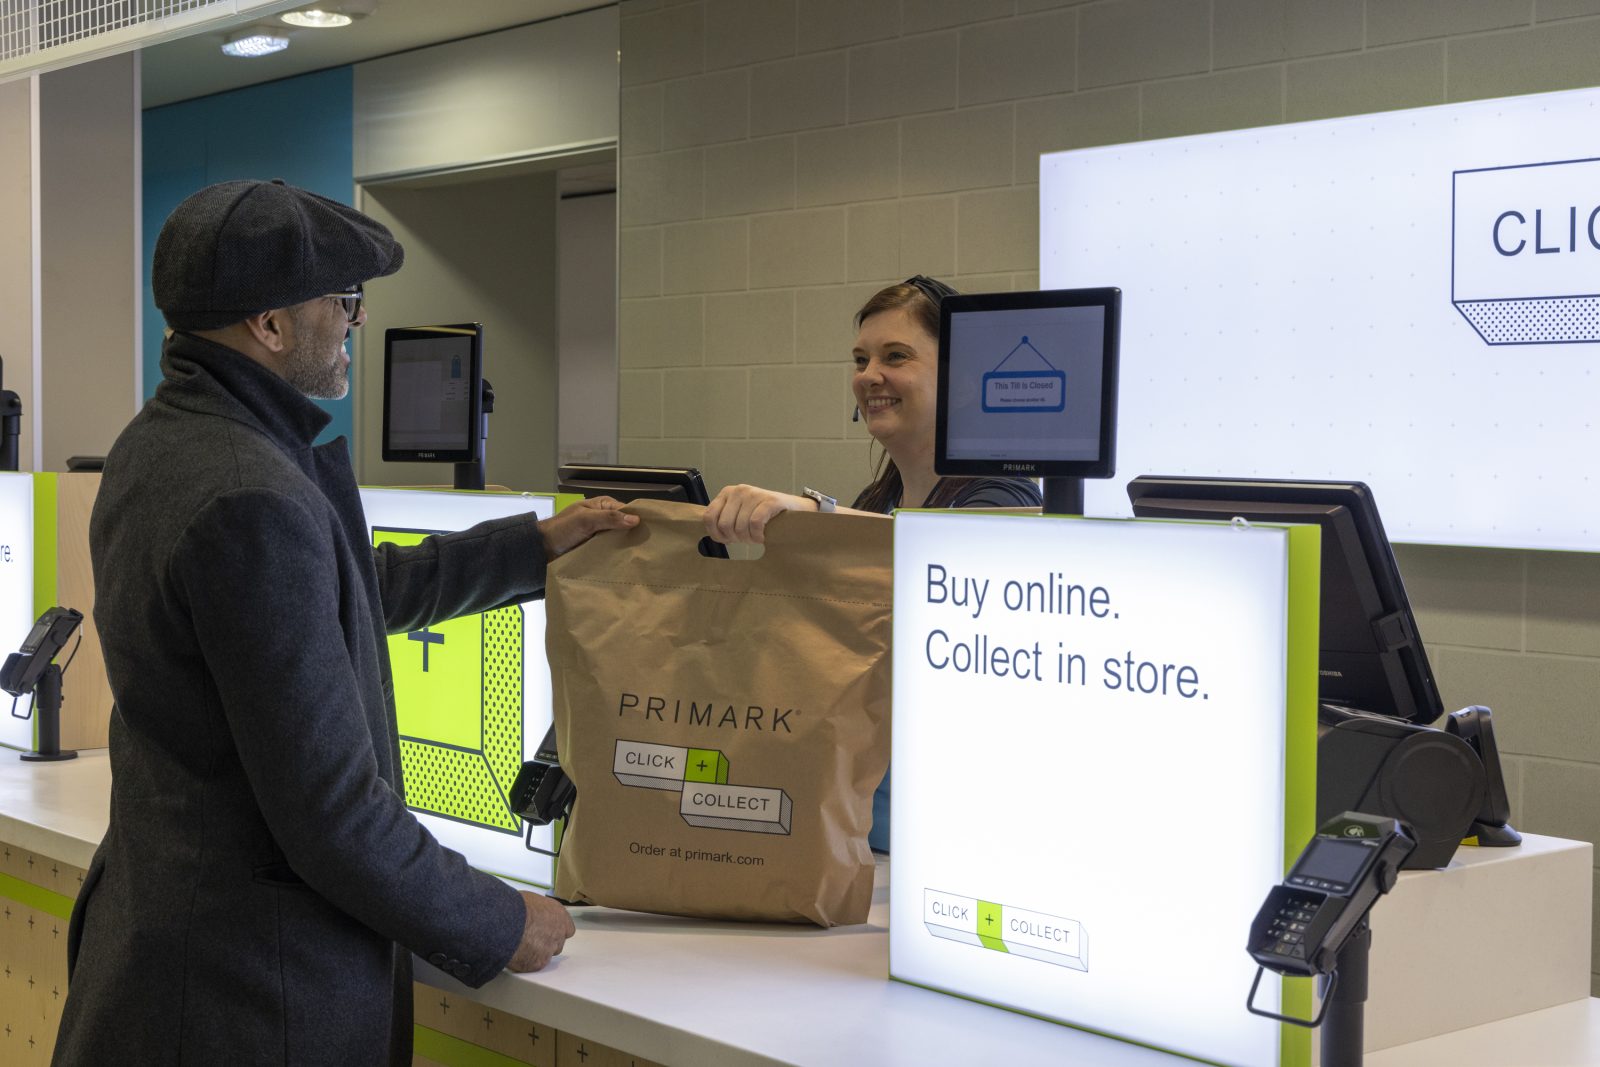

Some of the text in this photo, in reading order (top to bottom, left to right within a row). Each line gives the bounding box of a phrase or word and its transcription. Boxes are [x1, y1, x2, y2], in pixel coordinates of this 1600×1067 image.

[994, 381, 1009, 390] This
[1029, 380, 1054, 390] Closed
[1003, 463, 1036, 471] PRIMARK
[926, 563, 1120, 619] Buy online.
[925, 629, 1209, 700] Collect in store.
[1319, 670, 1343, 678] OSHIBA
[618, 693, 793, 733] PRIMARK
[625, 751, 676, 770] CLICK
[692, 792, 771, 812] COLLECT
[629, 842, 765, 867] Order at primark.com
[932, 901, 969, 921] CLICK
[1010, 918, 1071, 944] COLLECT
